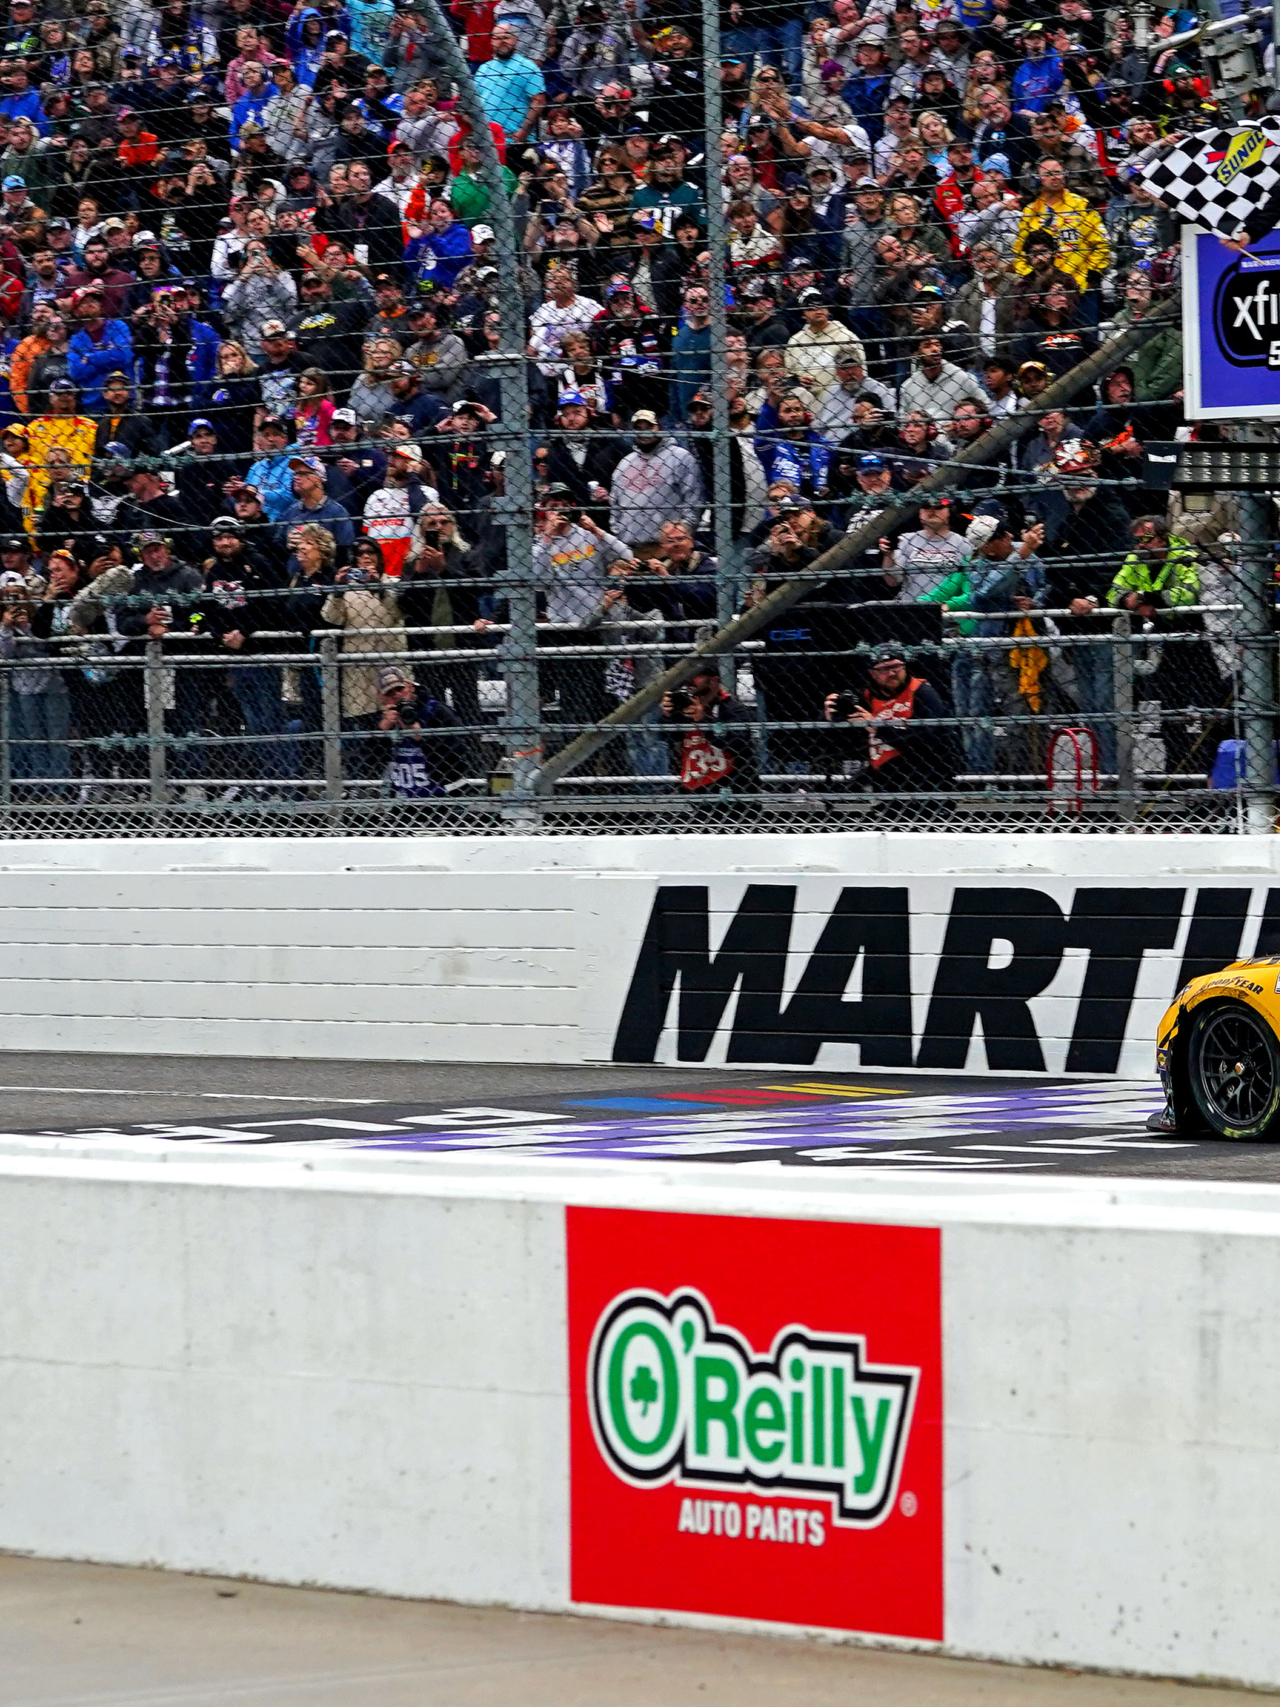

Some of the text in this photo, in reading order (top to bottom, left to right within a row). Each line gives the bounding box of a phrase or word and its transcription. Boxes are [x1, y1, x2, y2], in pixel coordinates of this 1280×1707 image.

[1221, 131, 1265, 182] SUNOC
[606, 1318, 893, 1496] O'Reilly
[678, 1497, 826, 1547] AUTO PARTS
